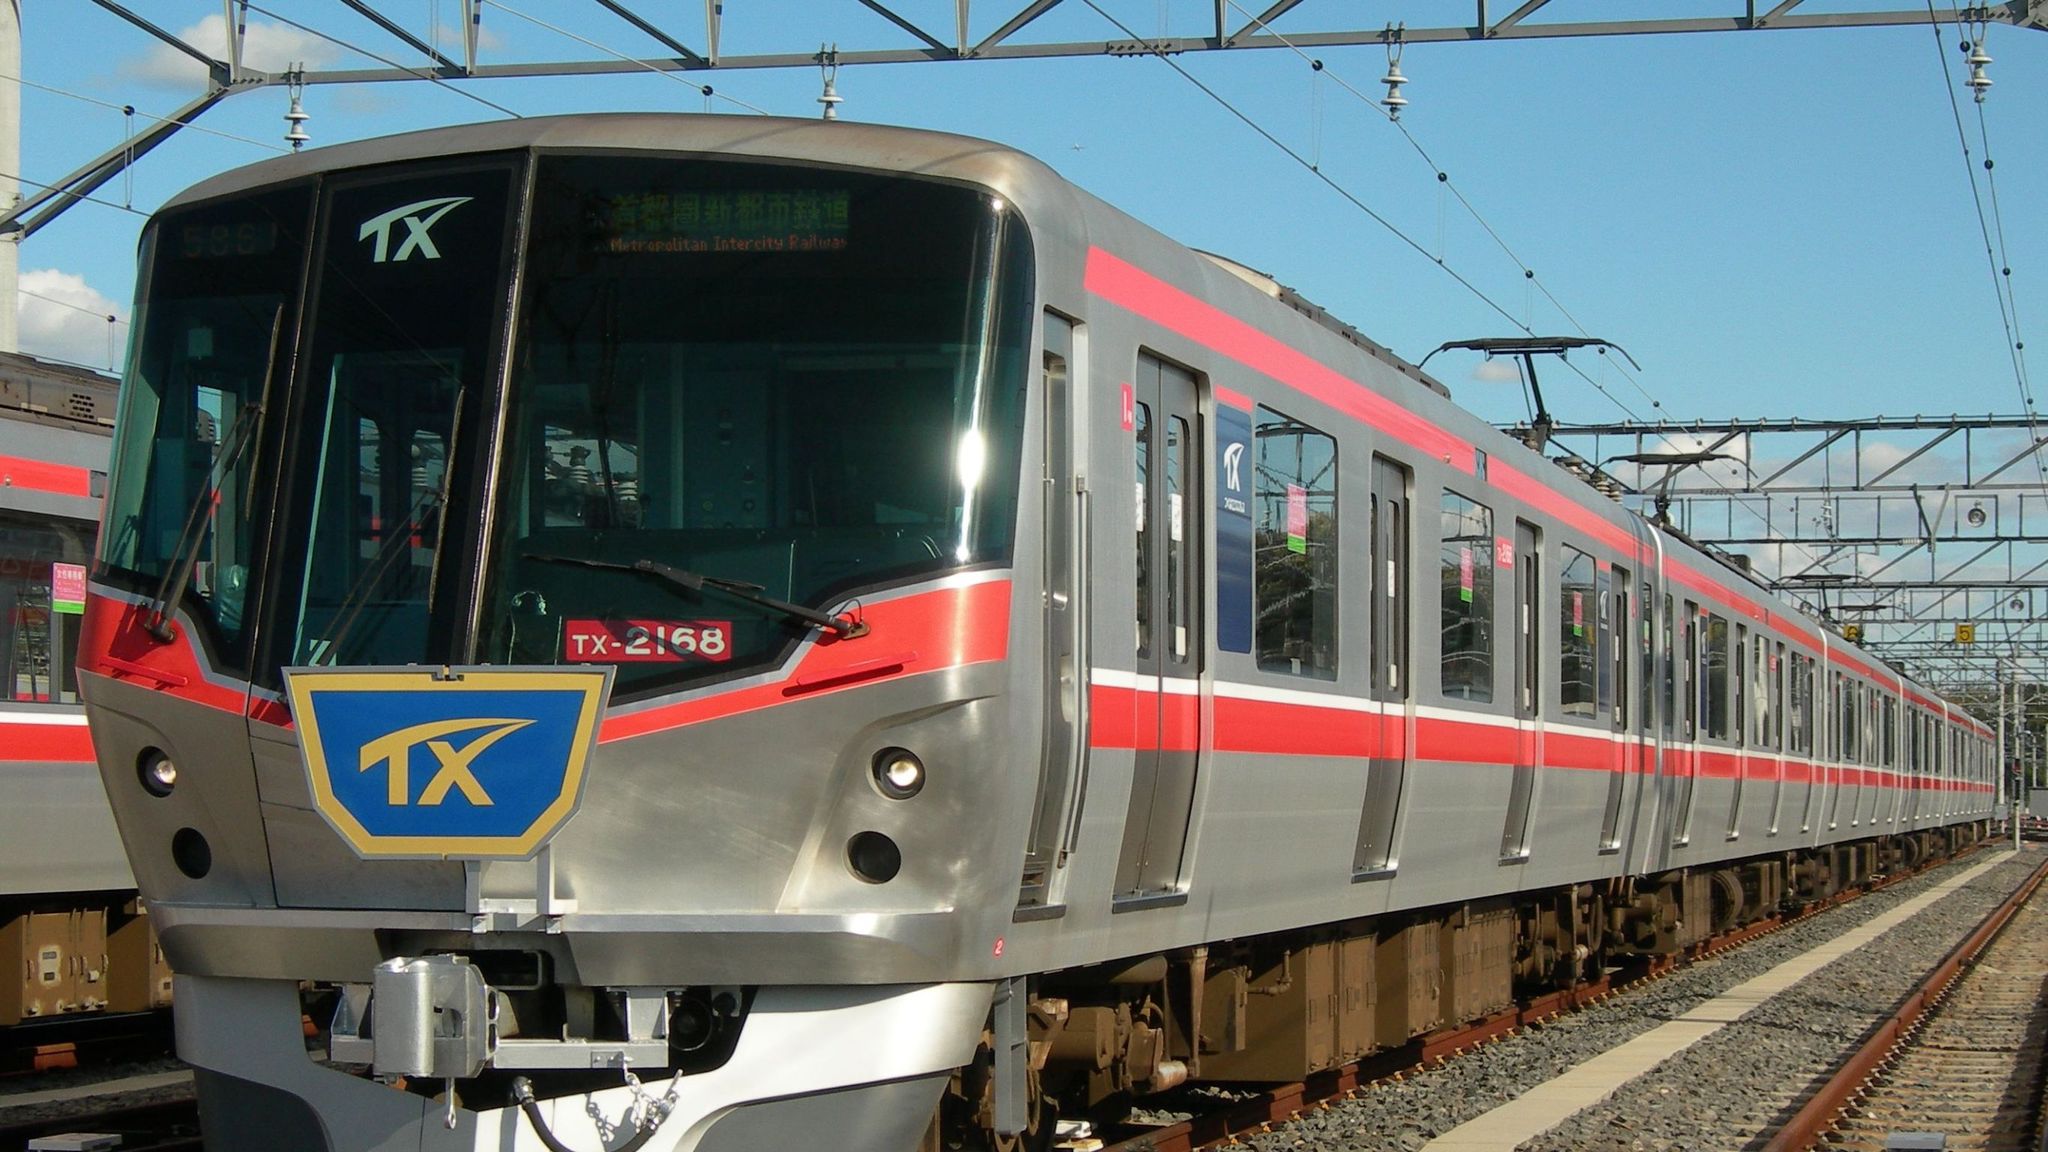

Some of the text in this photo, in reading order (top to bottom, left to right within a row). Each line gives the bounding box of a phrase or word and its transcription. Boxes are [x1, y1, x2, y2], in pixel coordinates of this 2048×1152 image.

[359, 196, 475, 263] TX
[610, 237, 708, 252] Metropolitan
[713, 234, 784, 251] Intercity
[572, 626, 726, 655] TX-2168
[1959, 625, 1970, 641] 5
[359, 717, 538, 806] TX
